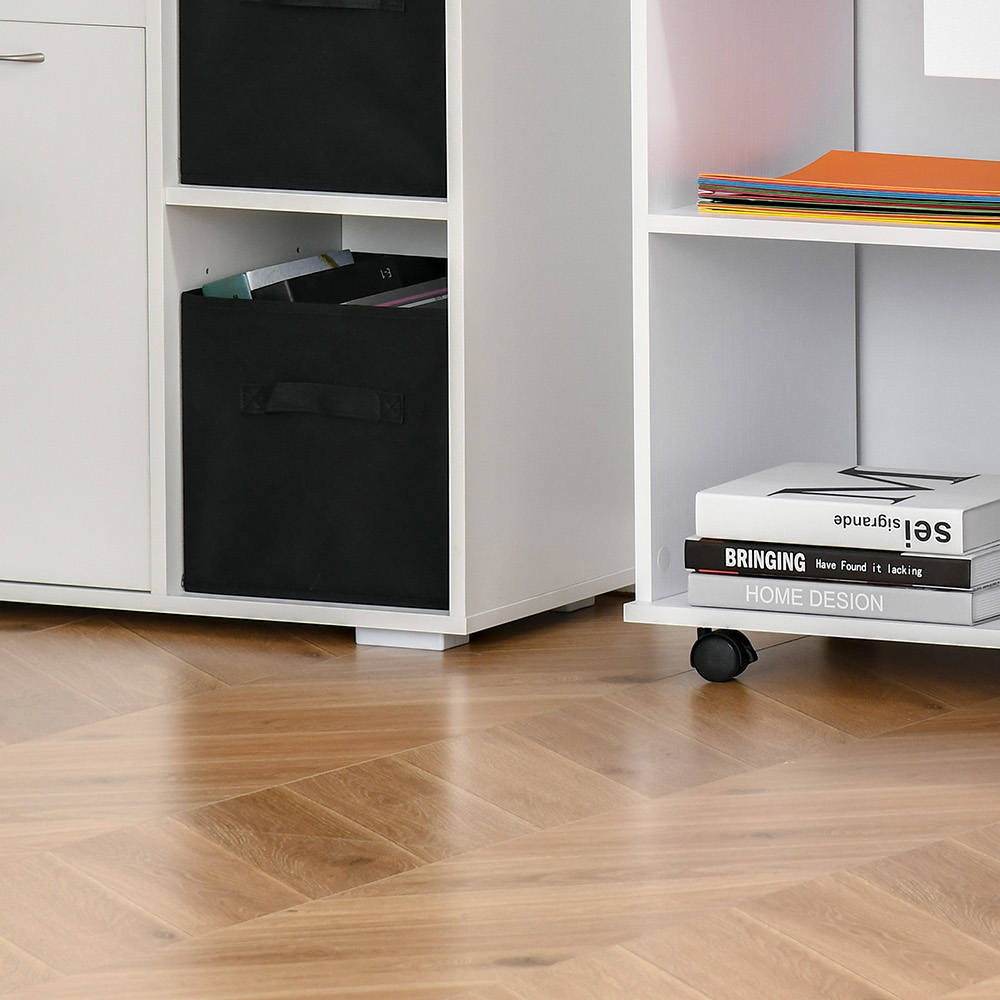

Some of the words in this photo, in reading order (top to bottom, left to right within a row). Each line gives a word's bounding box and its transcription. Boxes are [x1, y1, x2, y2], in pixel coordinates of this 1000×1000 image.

[833, 513, 901, 532] sigrande
[904, 519, 952, 549] sei
[725, 547, 806, 574] BRINGING
[815, 558, 837, 570] Have
[840, 560, 867, 572] Found
[872, 562, 882, 574] it
[887, 563, 923, 578] lacking
[746, 584, 804, 606] HOME
[809, 589, 884, 612] DESION
